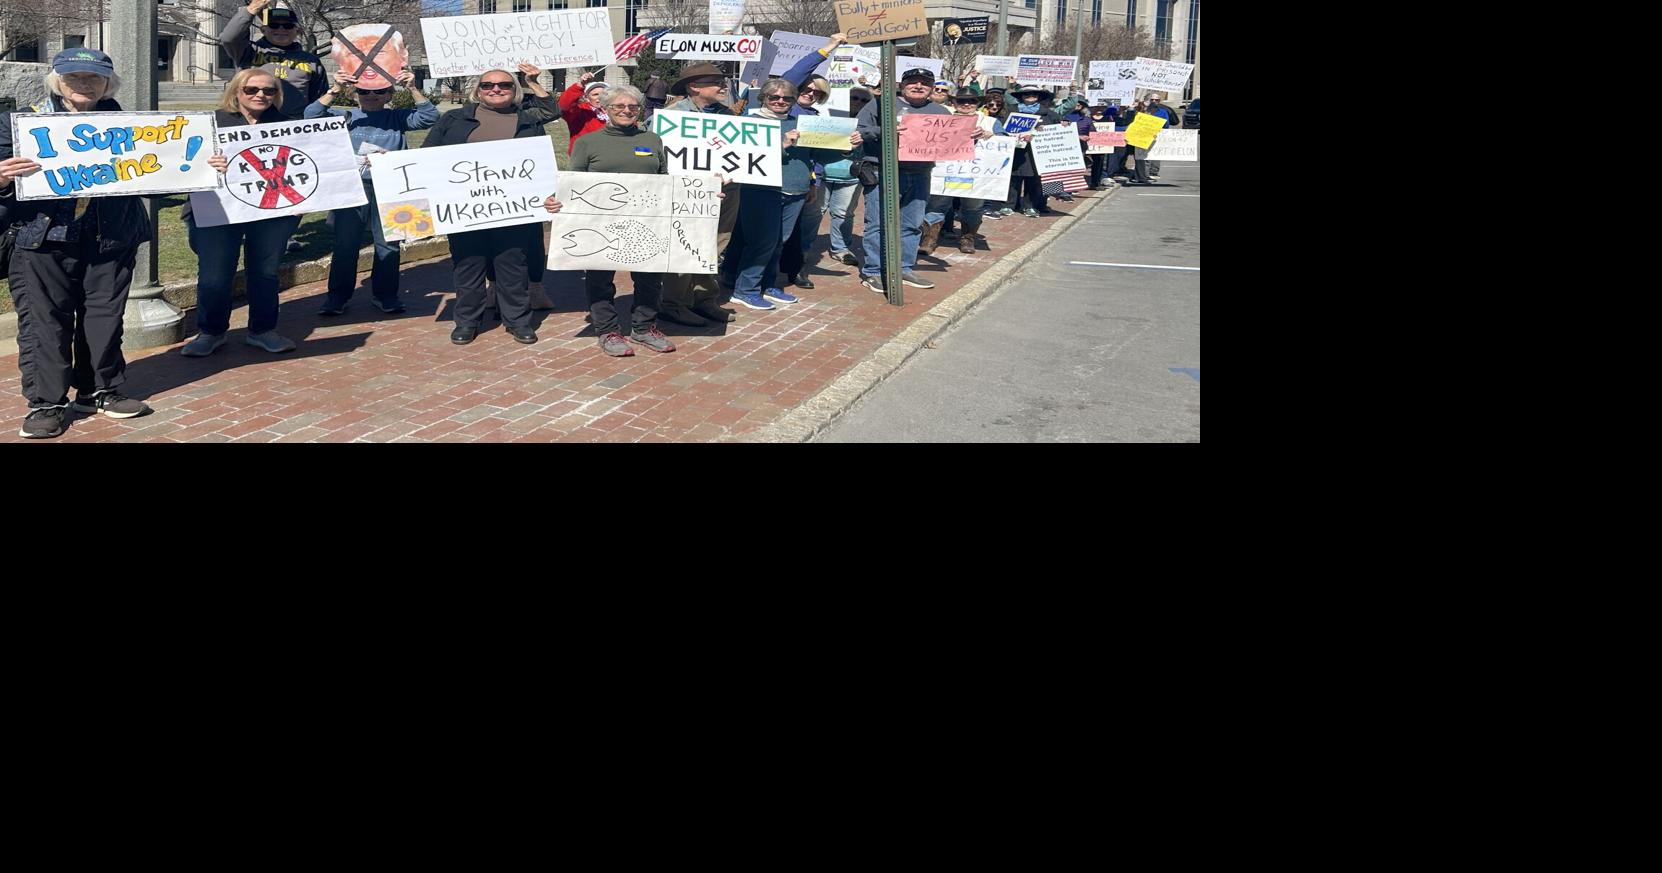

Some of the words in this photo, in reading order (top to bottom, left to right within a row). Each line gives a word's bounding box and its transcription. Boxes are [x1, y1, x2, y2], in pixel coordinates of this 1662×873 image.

[436, 19, 496, 40] JOIN
[517, 13, 573, 33] FIGHT
[579, 11, 608, 29] FOR
[846, 22, 882, 39] Good
[439, 31, 576, 58] DEMOCRACY!
[660, 39, 697, 52] ELON
[701, 40, 736, 53] MUSK
[737, 38, 761, 54] GO!
[432, 63, 468, 76] Together
[471, 61, 486, 72] We
[490, 59, 505, 68] Can
[544, 50, 600, 65] Difference!
[218, 131, 251, 144] END
[261, 120, 347, 138] DEMOCRACY
[657, 114, 780, 147] DEPORT
[922, 118, 961, 127] SAVE
[29, 126, 58, 158] I
[66, 116, 189, 155] Support
[259, 145, 274, 154] NO
[239, 153, 306, 173] KING
[664, 145, 767, 177] MUSK
[44, 153, 162, 196] Ukraine
[239, 173, 309, 194] TRUMP
[394, 162, 427, 194] I
[682, 177, 703, 189] DO
[470, 186, 504, 198] with
[687, 190, 716, 200] NOT
[672, 202, 719, 217] PANIC
[672, 220, 716, 271] ORGANIZE
